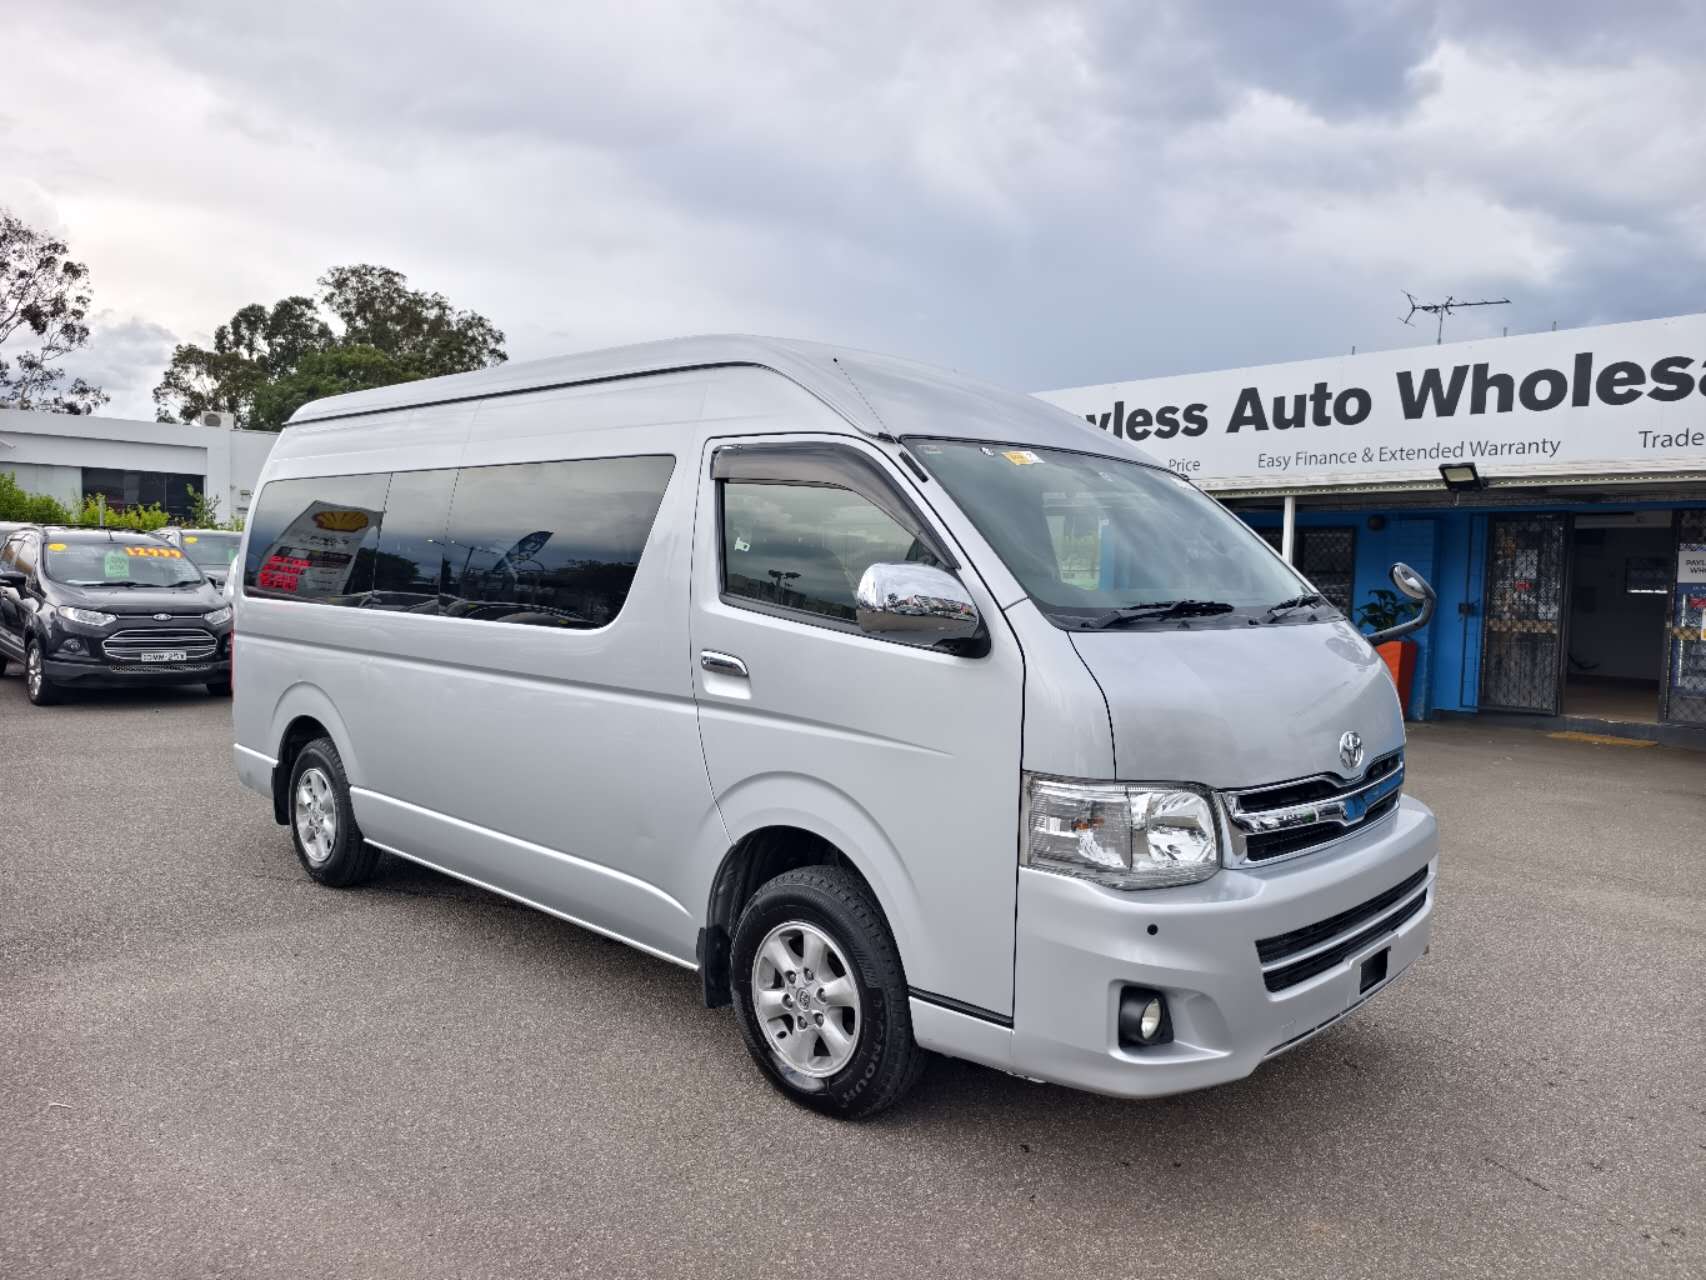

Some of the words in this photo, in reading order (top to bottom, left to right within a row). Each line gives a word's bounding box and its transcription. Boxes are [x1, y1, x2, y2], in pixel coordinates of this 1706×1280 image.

[1226, 383, 1372, 432] Auto
[1396, 352, 1706, 420] Wholes
[1639, 427, 1705, 449] Trade
[1168, 459, 1201, 473] Price
[1258, 451, 1289, 471] Easy
[1295, 450, 1357, 467] Finance
[1361, 447, 1374, 463] &
[1378, 441, 1465, 462] Extended
[1469, 438, 1562, 459] Warranty
